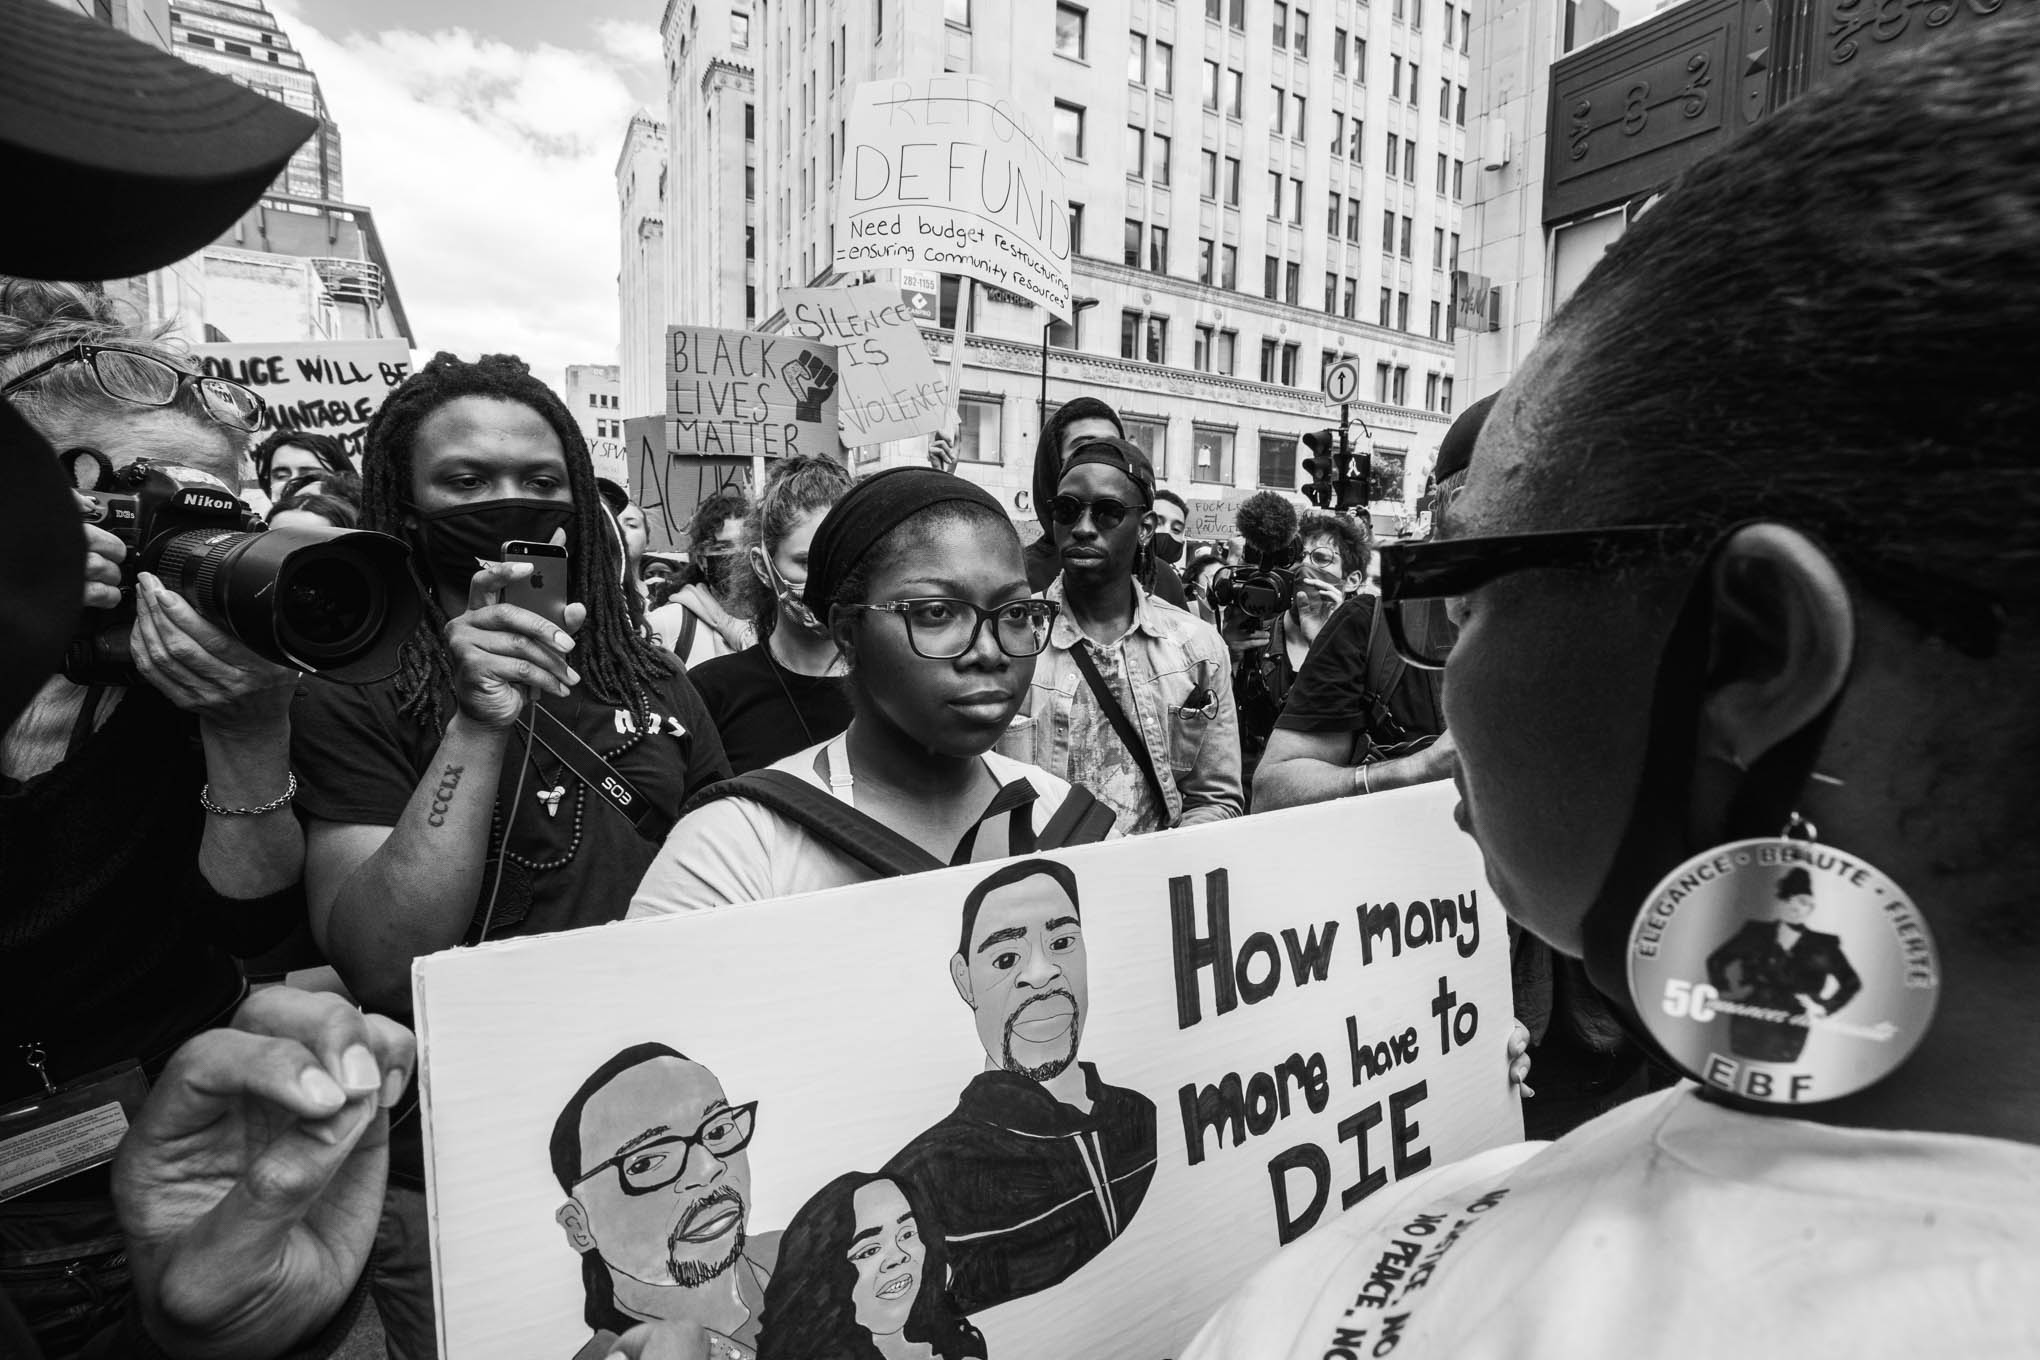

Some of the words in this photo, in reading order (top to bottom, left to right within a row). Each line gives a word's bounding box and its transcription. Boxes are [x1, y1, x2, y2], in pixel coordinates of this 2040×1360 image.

[855, 141, 1070, 260] DEFUND
[850, 213, 902, 238] Need
[918, 215, 985, 248] budget
[994, 233, 1070, 300] restructuring
[923, 247, 1008, 283] community
[1012, 272, 1066, 310] resources
[296, 355, 373, 385] WILL
[673, 331, 776, 380] BLACK
[837, 338, 889, 367] IS
[675, 379, 771, 423] LIVES
[676, 417, 799, 458] MATTER
[184, 493, 233, 510] Nikon
[427, 763, 464, 827] CCCLX
[601, 776, 632, 806] EOS
[1168, 867, 1339, 1030] How
[1356, 889, 1480, 966] many
[1178, 1052, 1330, 1166] more
[1345, 1014, 1420, 1088] have
[1431, 975, 1479, 1055] to
[1267, 1078, 1432, 1247] DIE
[1402, 1213, 1448, 1236] NO
[1372, 1312, 1412, 1358] NO
